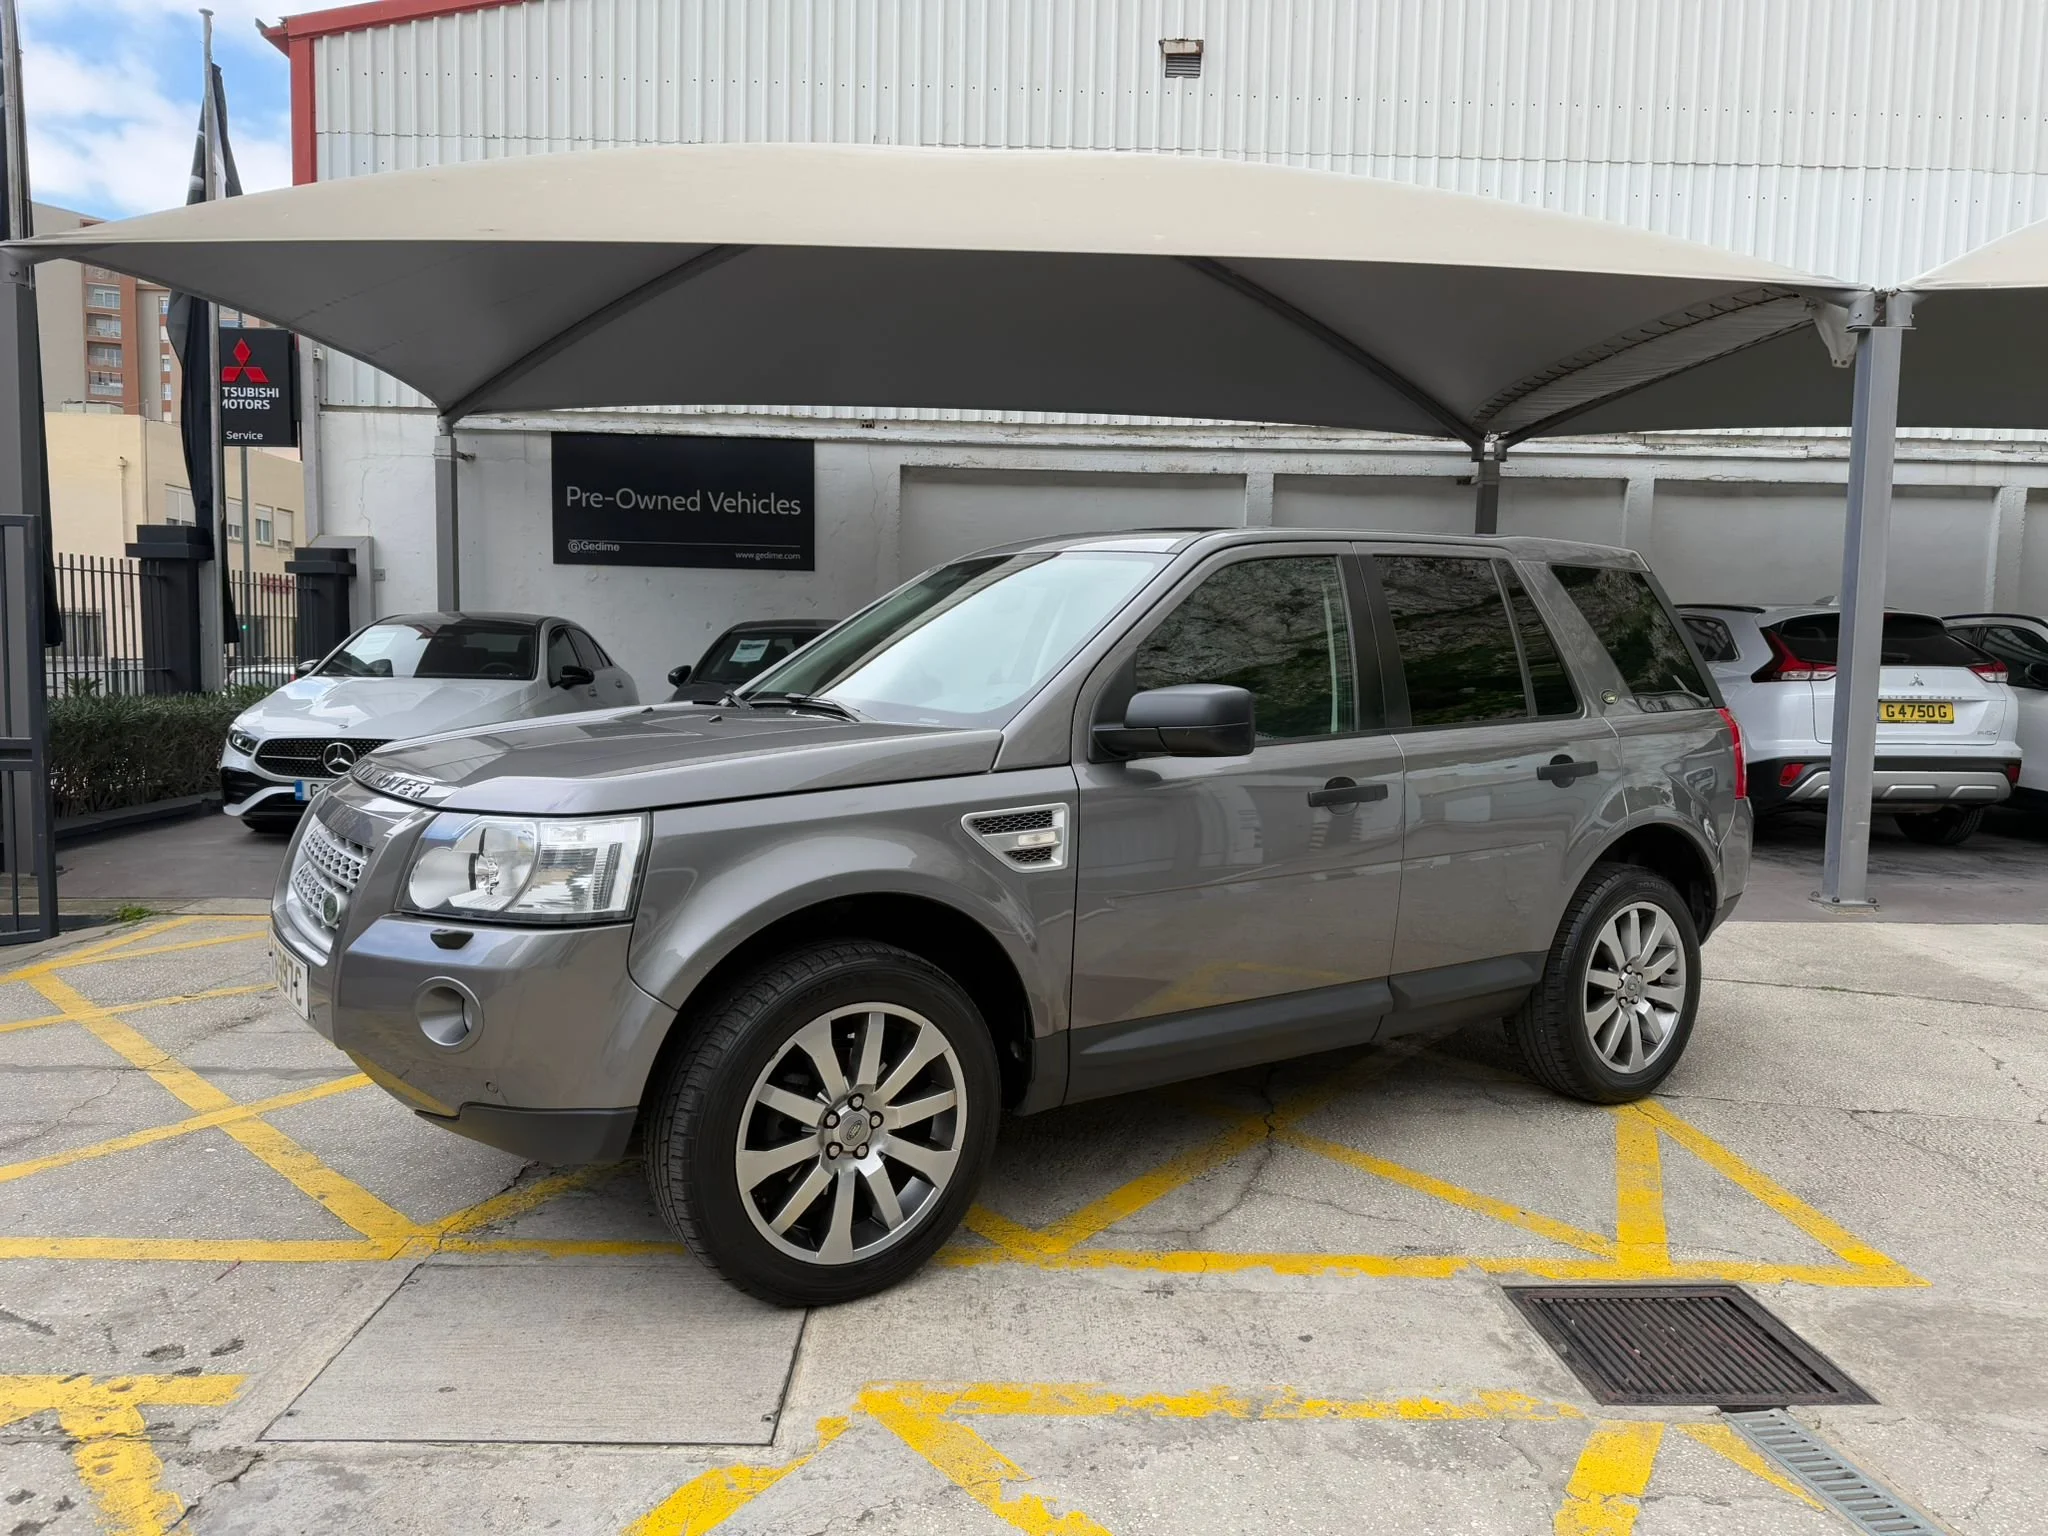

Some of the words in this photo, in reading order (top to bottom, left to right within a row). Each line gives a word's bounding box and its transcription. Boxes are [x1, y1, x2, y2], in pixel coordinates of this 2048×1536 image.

[222, 387, 280, 398] TSUBISHI
[226, 430, 263, 440] Service
[566, 486, 701, 512] Pre-Owned
[707, 489, 801, 516] Vehicles
[735, 551, 801, 561] www.gedime.com
